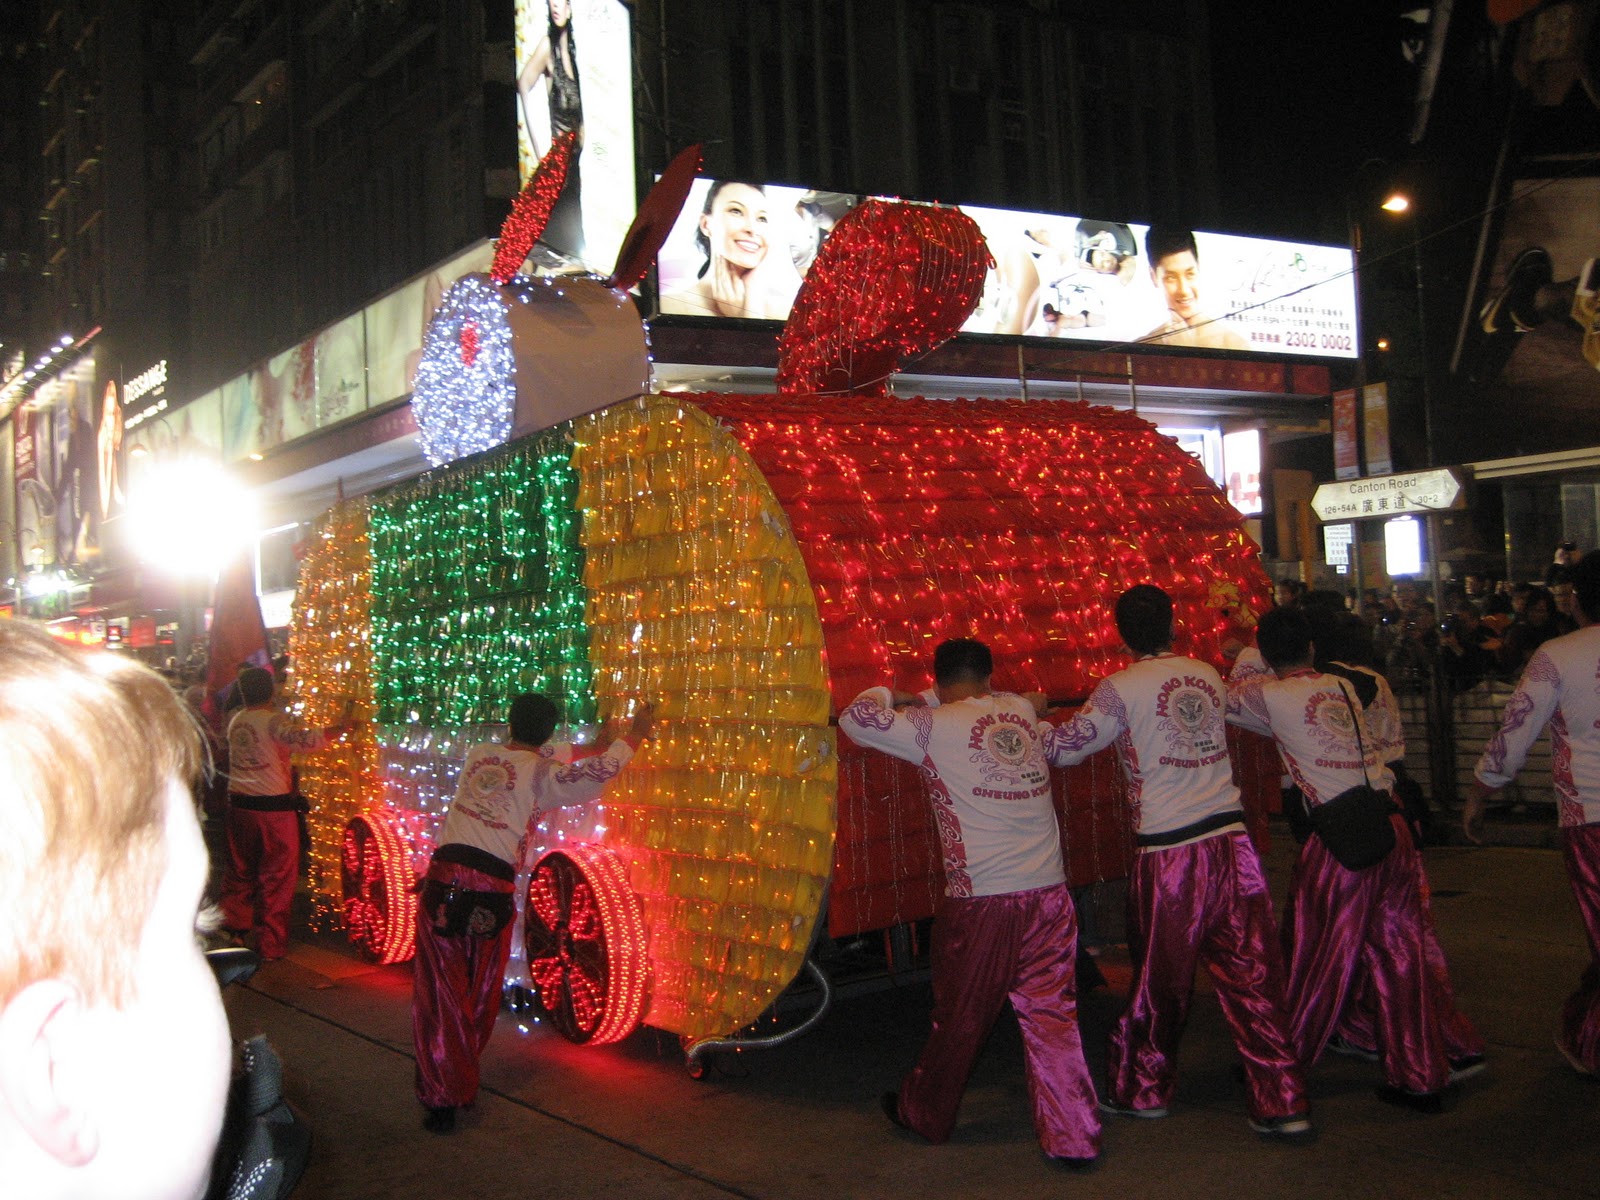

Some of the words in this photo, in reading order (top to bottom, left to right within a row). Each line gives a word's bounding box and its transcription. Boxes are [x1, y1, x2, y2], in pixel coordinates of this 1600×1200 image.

[1286, 331, 1317, 348] 2302
[1321, 333, 1352, 351] 0002
[1349, 481, 1386, 494] Canton
[1388, 477, 1417, 490] Road
[1362, 495, 1406, 513] 廣東道
[1156, 677, 1182, 717] HONG
[1183, 675, 1221, 709] KONG
[968, 713, 997, 750] HONG
[997, 712, 1038, 741] KONG
[972, 786, 1031, 801] CHEUNG
